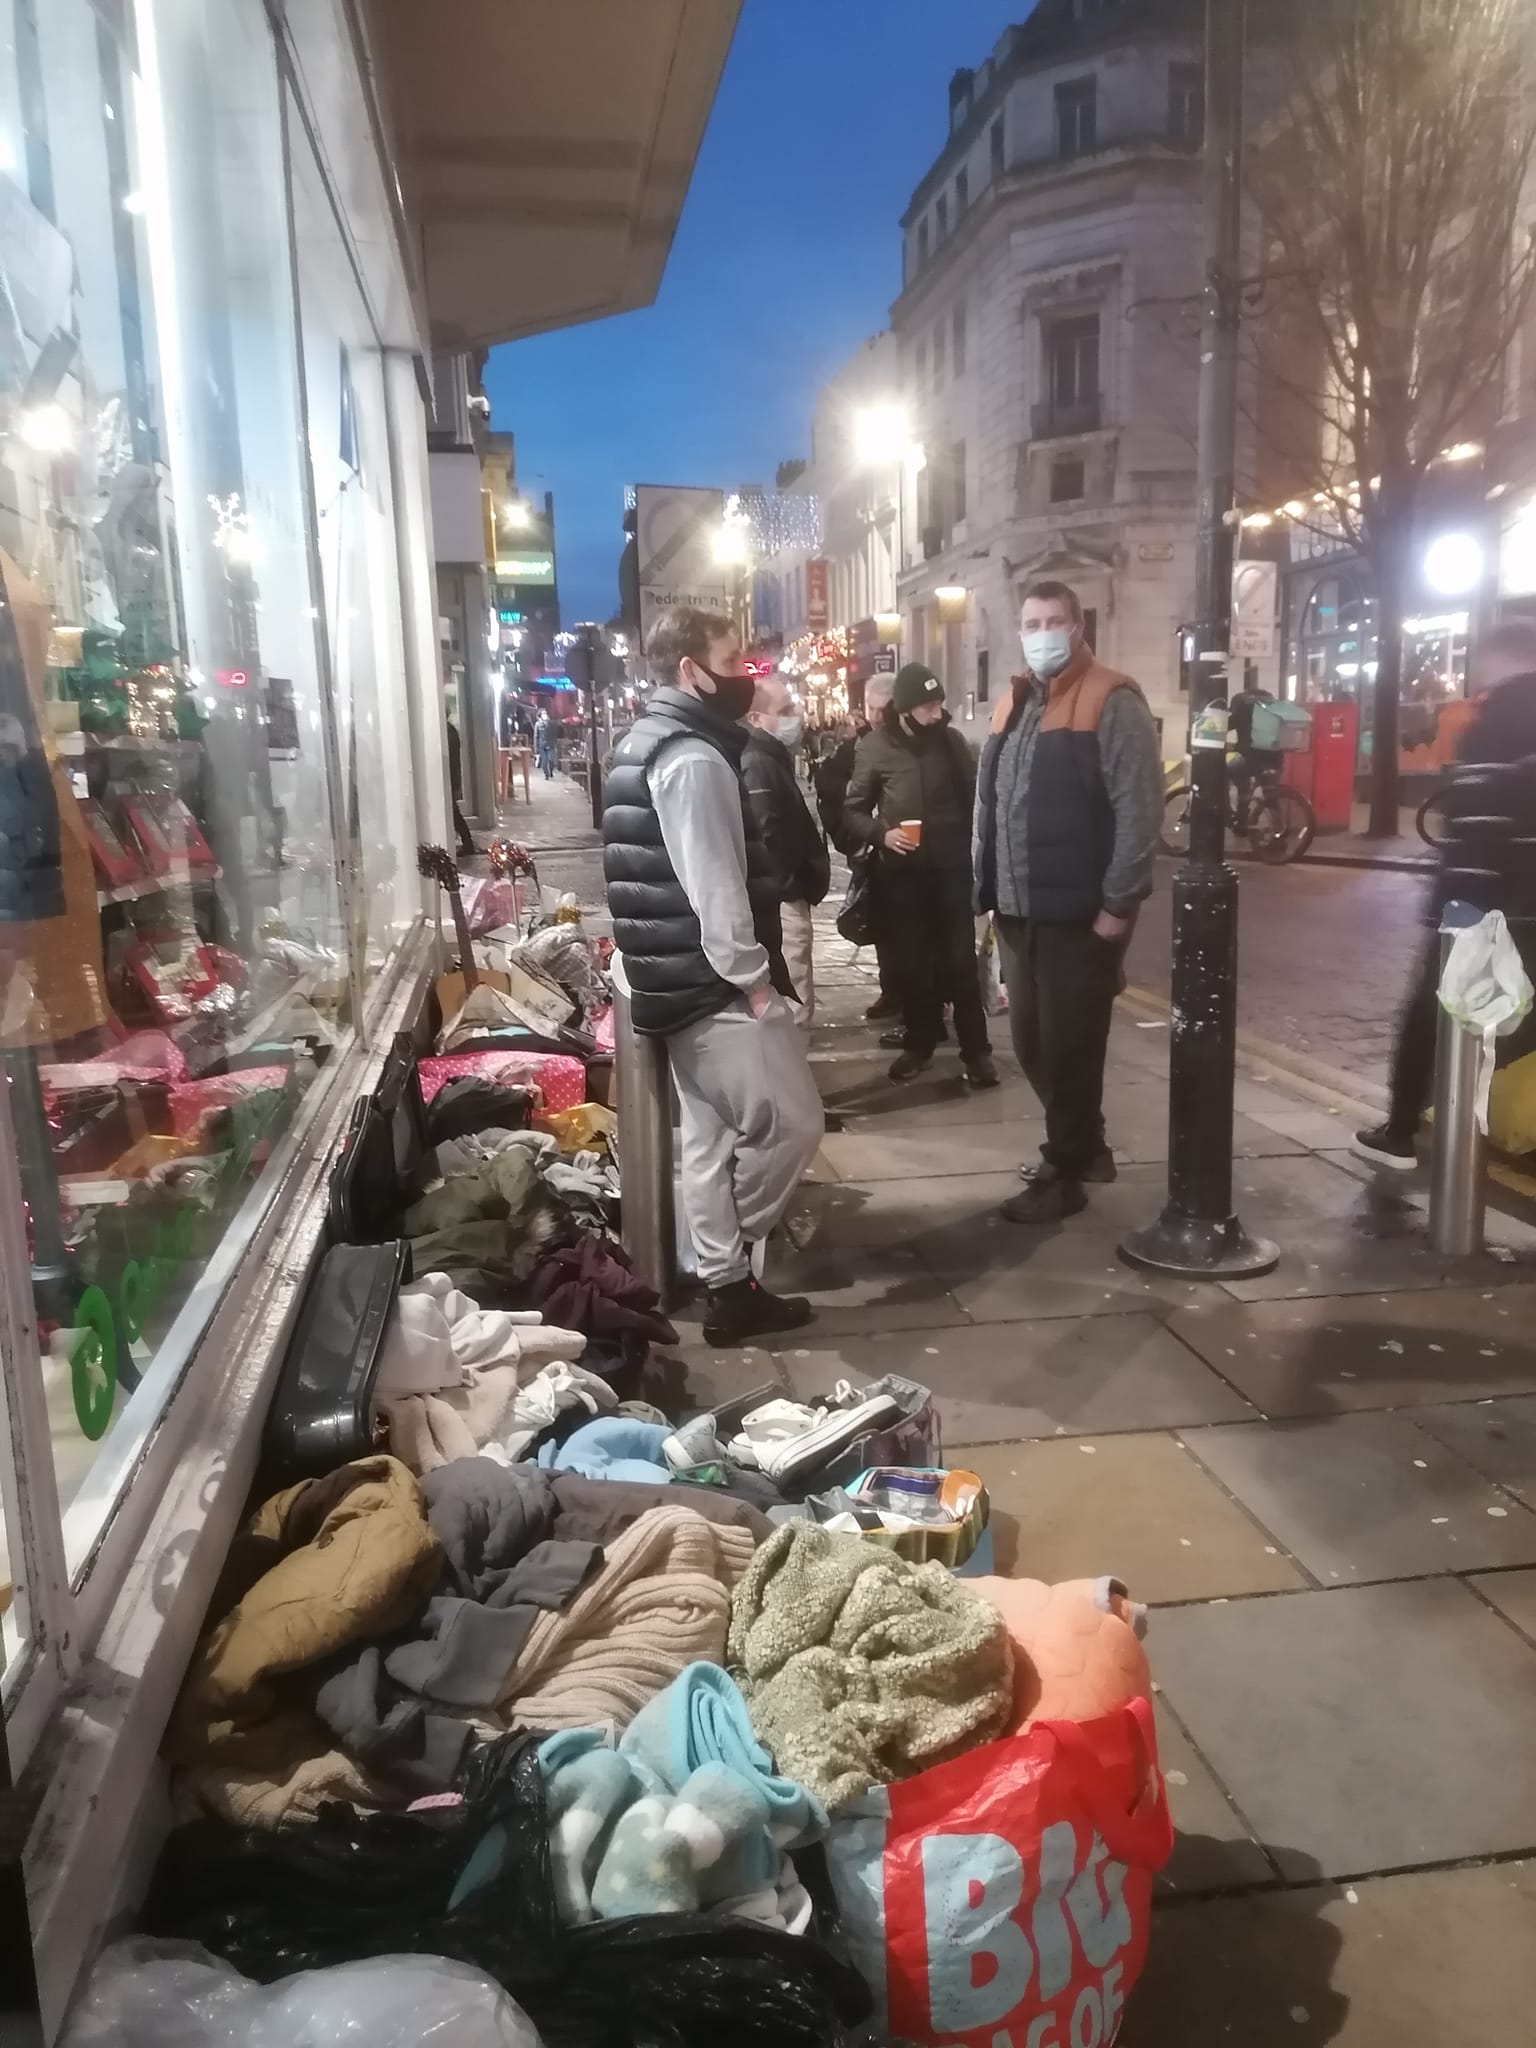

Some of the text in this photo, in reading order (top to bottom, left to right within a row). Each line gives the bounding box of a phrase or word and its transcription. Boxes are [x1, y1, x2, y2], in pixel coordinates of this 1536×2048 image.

[645, 590, 719, 607] Pedetrin
[921, 1820, 1132, 2033] BIG
[1070, 1961, 1125, 2048] OF
